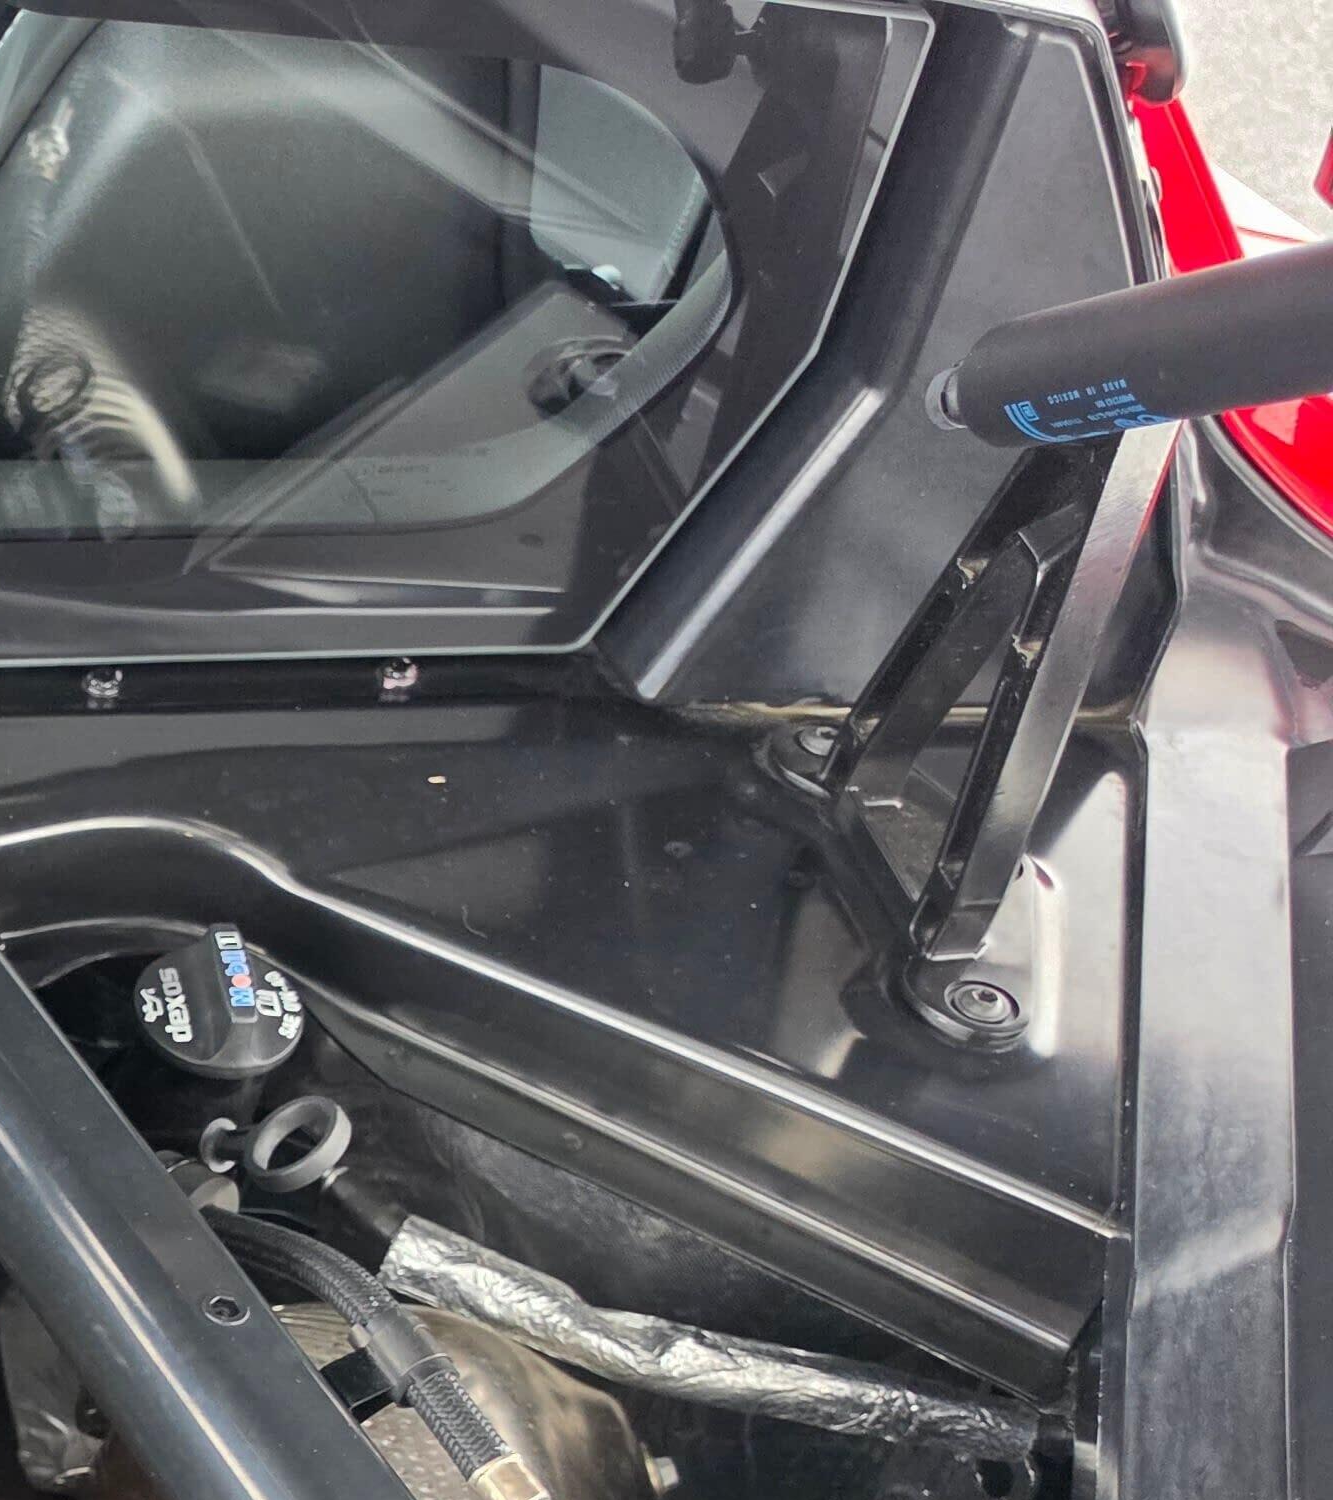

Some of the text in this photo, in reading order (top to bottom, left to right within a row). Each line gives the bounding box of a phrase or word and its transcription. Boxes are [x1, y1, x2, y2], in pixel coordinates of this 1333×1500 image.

[1047, 389, 1081, 405] MEXICO
[159, 967, 193, 1043] dexos
[219, 950, 256, 1007] Mobil
